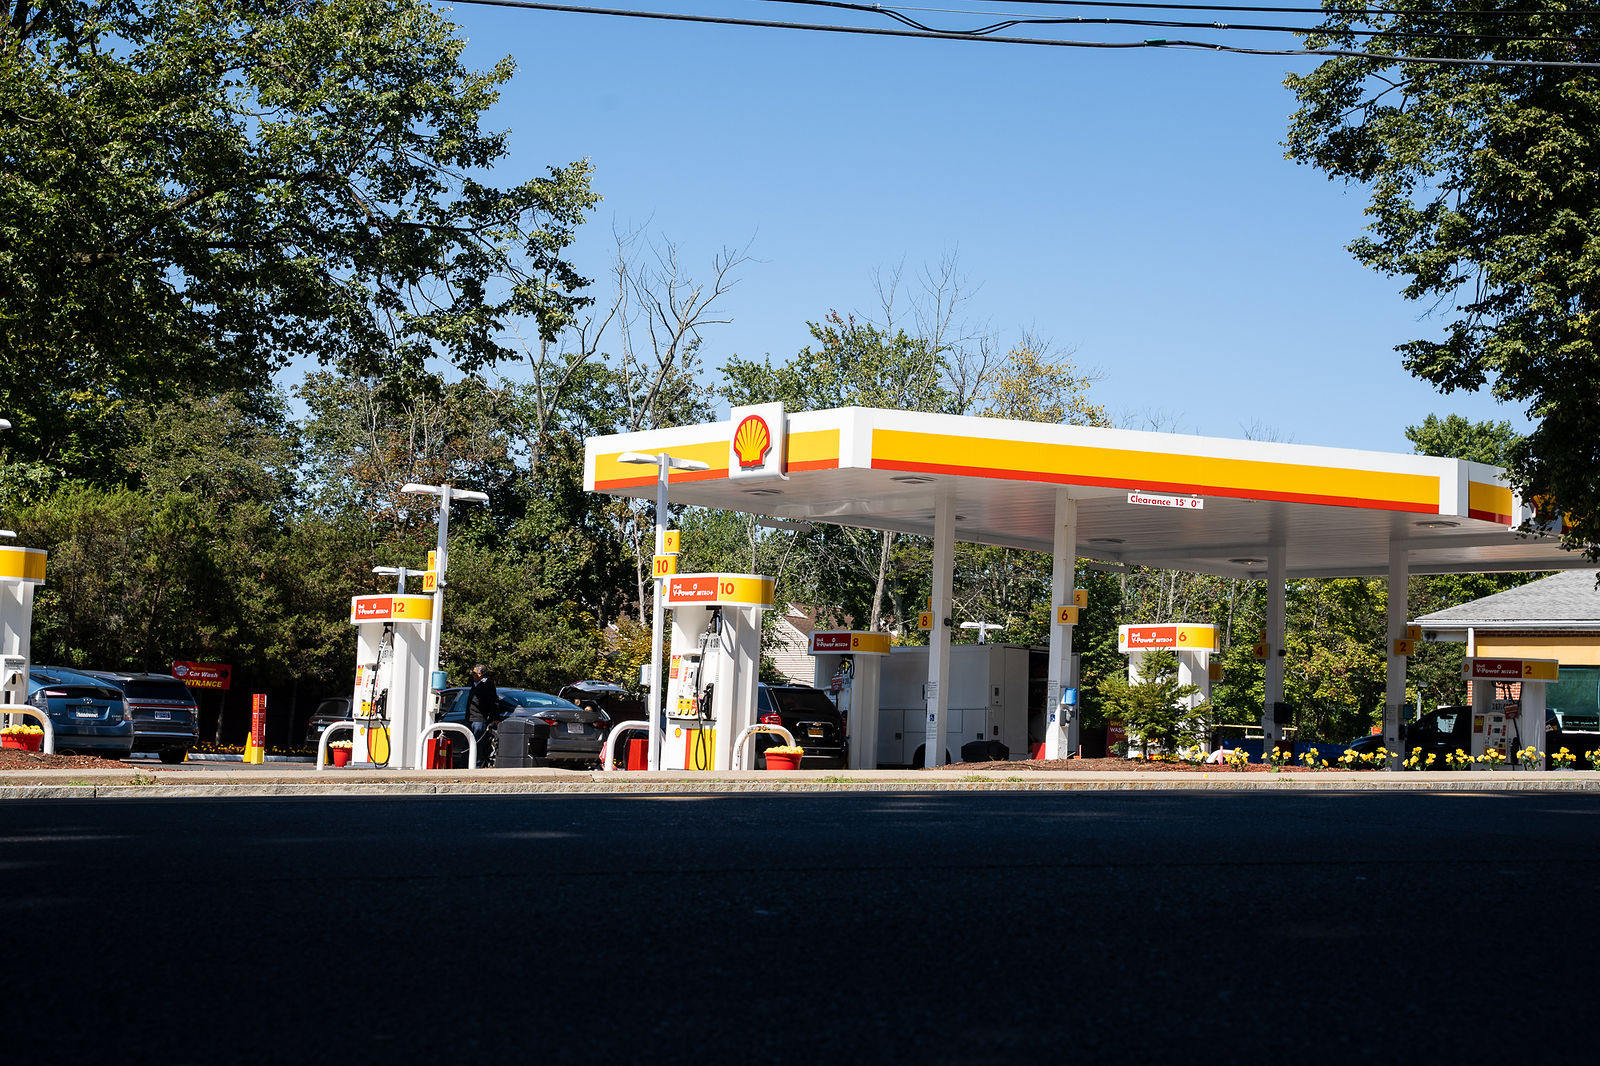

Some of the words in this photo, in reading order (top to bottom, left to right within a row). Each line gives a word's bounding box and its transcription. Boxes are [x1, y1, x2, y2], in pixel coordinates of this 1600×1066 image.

[1130, 495, 1171, 506] Clearance
[667, 537, 673, 546] 9
[657, 559, 669, 573] 10
[426, 575, 434, 588] 12
[720, 582, 735, 595] 10
[1076, 594, 1081, 602] 5
[393, 602, 405, 613] 12
[1061, 609, 1069, 621] 6
[922, 615, 928, 627] 8
[1178, 631, 1187, 642] 6
[853, 637, 859, 648] 8
[1399, 641, 1407, 652] 2
[1256, 646, 1263, 657] 4
[1525, 665, 1533, 674] 2
[182, 679, 222, 688] NTRANCE
